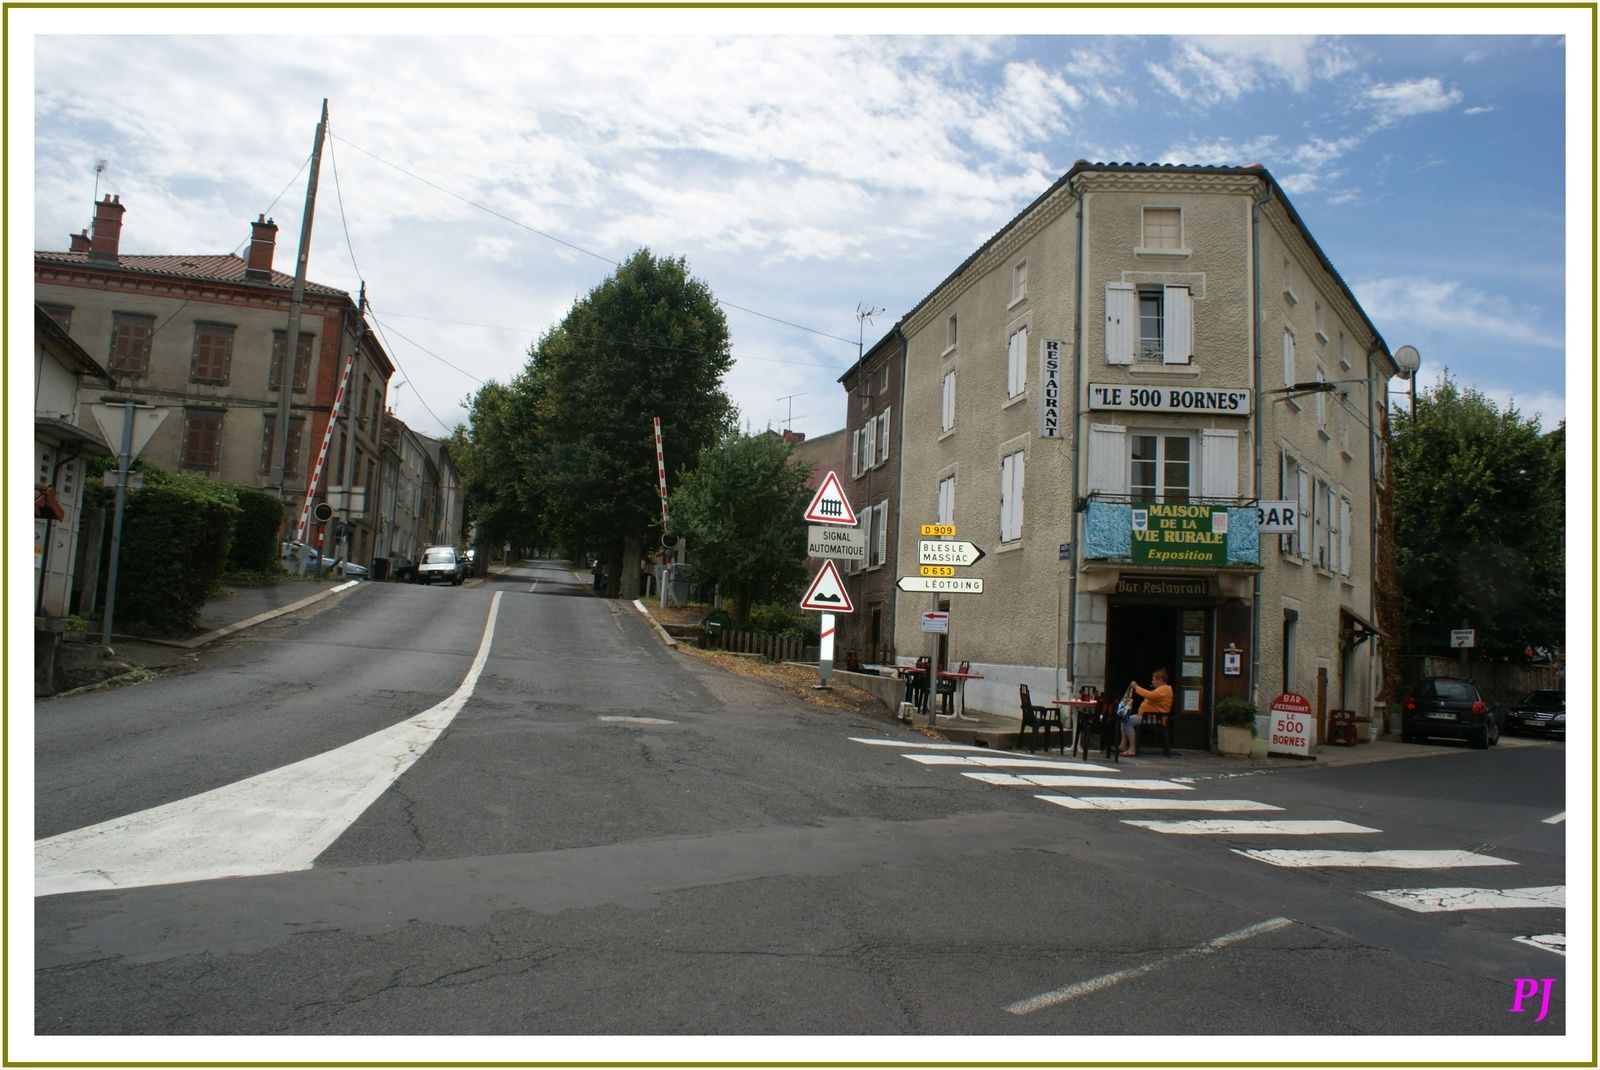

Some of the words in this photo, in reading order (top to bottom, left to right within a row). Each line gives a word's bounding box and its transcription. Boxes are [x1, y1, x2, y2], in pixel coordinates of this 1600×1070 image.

[1046, 341, 1058, 437] RESTAURANT
[1129, 389, 1161, 407] 500
[1149, 504, 1210, 518] MAISON
[1160, 519, 1177, 529] DE
[1182, 519, 1197, 529] LA
[823, 531, 851, 541] SIGNAL
[925, 526, 931, 534] D
[934, 526, 953, 535] 909
[1134, 530, 1159, 542] VIE
[1164, 530, 1223, 544] RURALE
[809, 543, 864, 556] AUTOMATIQUE
[923, 543, 964, 553] BLESLE
[923, 553, 968, 562] MASSIAC
[1148, 549, 1213, 561] Exposition
[923, 567, 929, 575] D
[932, 567, 952, 576] 653
[925, 579, 980, 590] LÉOTOING
[1118, 581, 1138, 593] Bar
[1142, 581, 1207, 595] Restaurant
[1283, 694, 1301, 703] BAR
[1273, 703, 1309, 712] RESTAURANT
[1277, 720, 1304, 734] 500
[1272, 734, 1306, 748] BORNES
